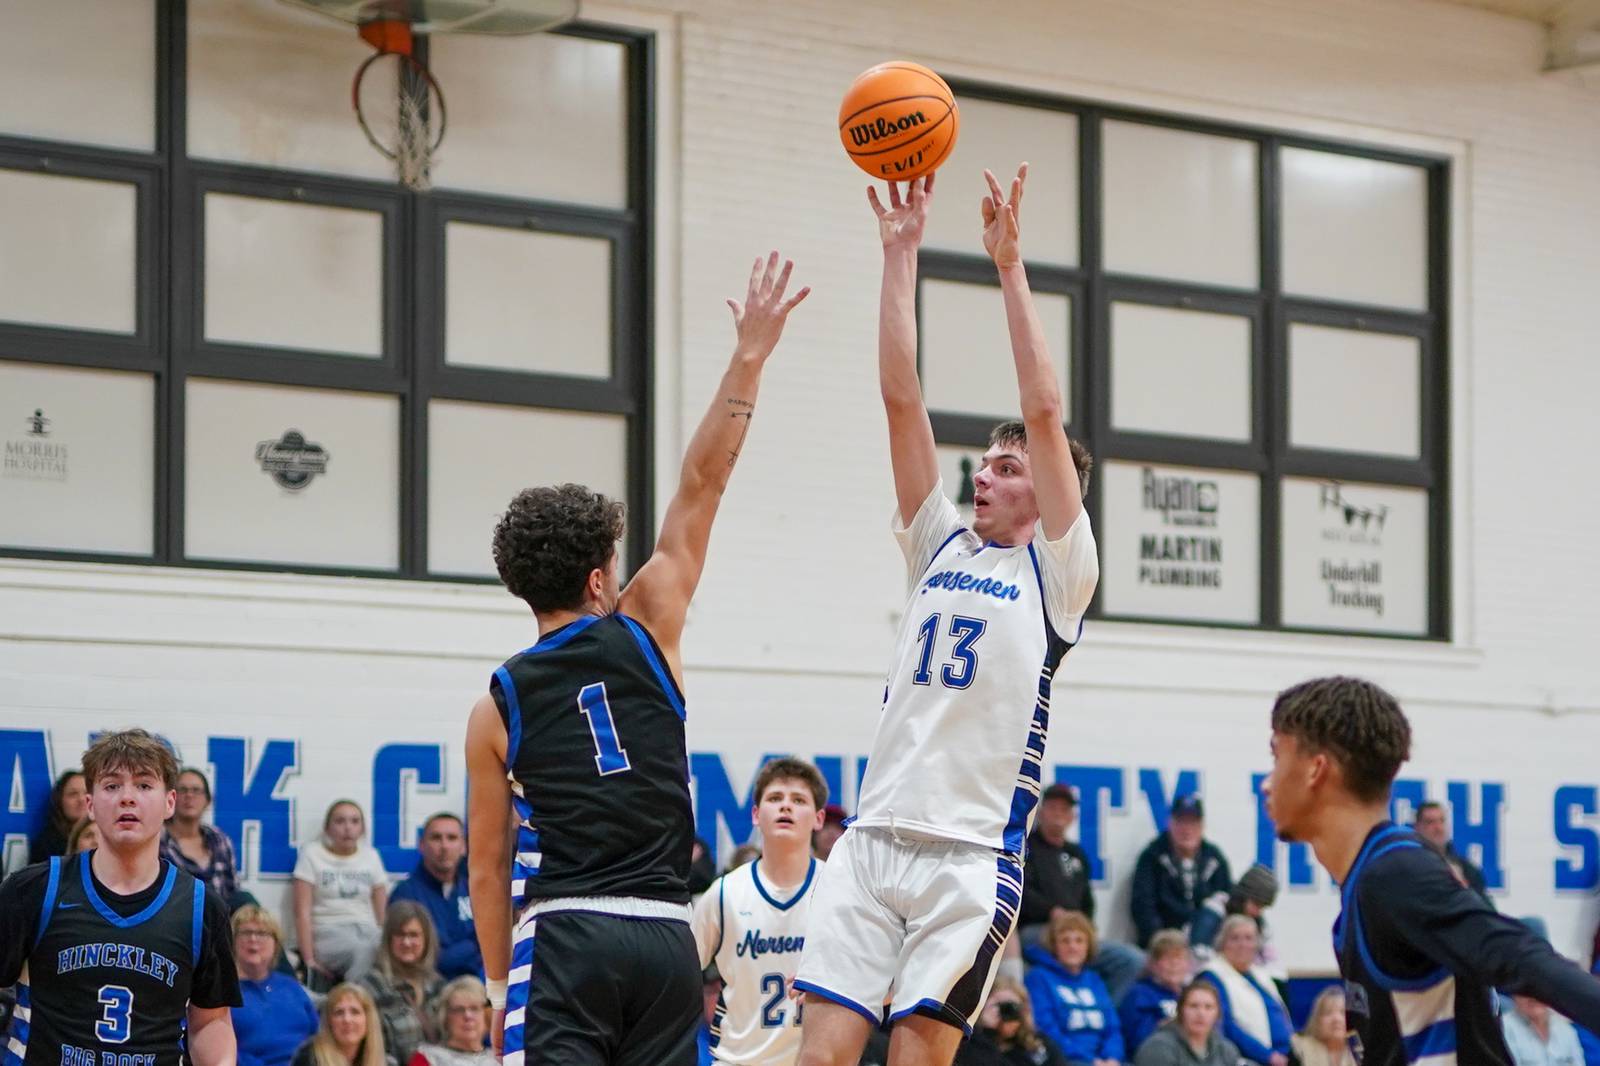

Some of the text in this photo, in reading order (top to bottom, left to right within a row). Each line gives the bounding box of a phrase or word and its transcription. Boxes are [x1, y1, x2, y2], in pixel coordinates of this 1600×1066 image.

[849, 111, 926, 147] Wilson
[5, 440, 69, 458] MORRIS
[4, 459, 68, 474] HOSPITAL
[1140, 535, 1222, 562] MARTIN
[921, 570, 1021, 601] orsemen
[1139, 566, 1221, 588] PLUMBING
[1321, 559, 1380, 584] Underhill
[1329, 583, 1384, 616] Trucking
[912, 612, 987, 690] 13
[577, 681, 631, 777] 1
[57, 942, 179, 988] HINCKLEY
[95, 984, 134, 1044] 3
